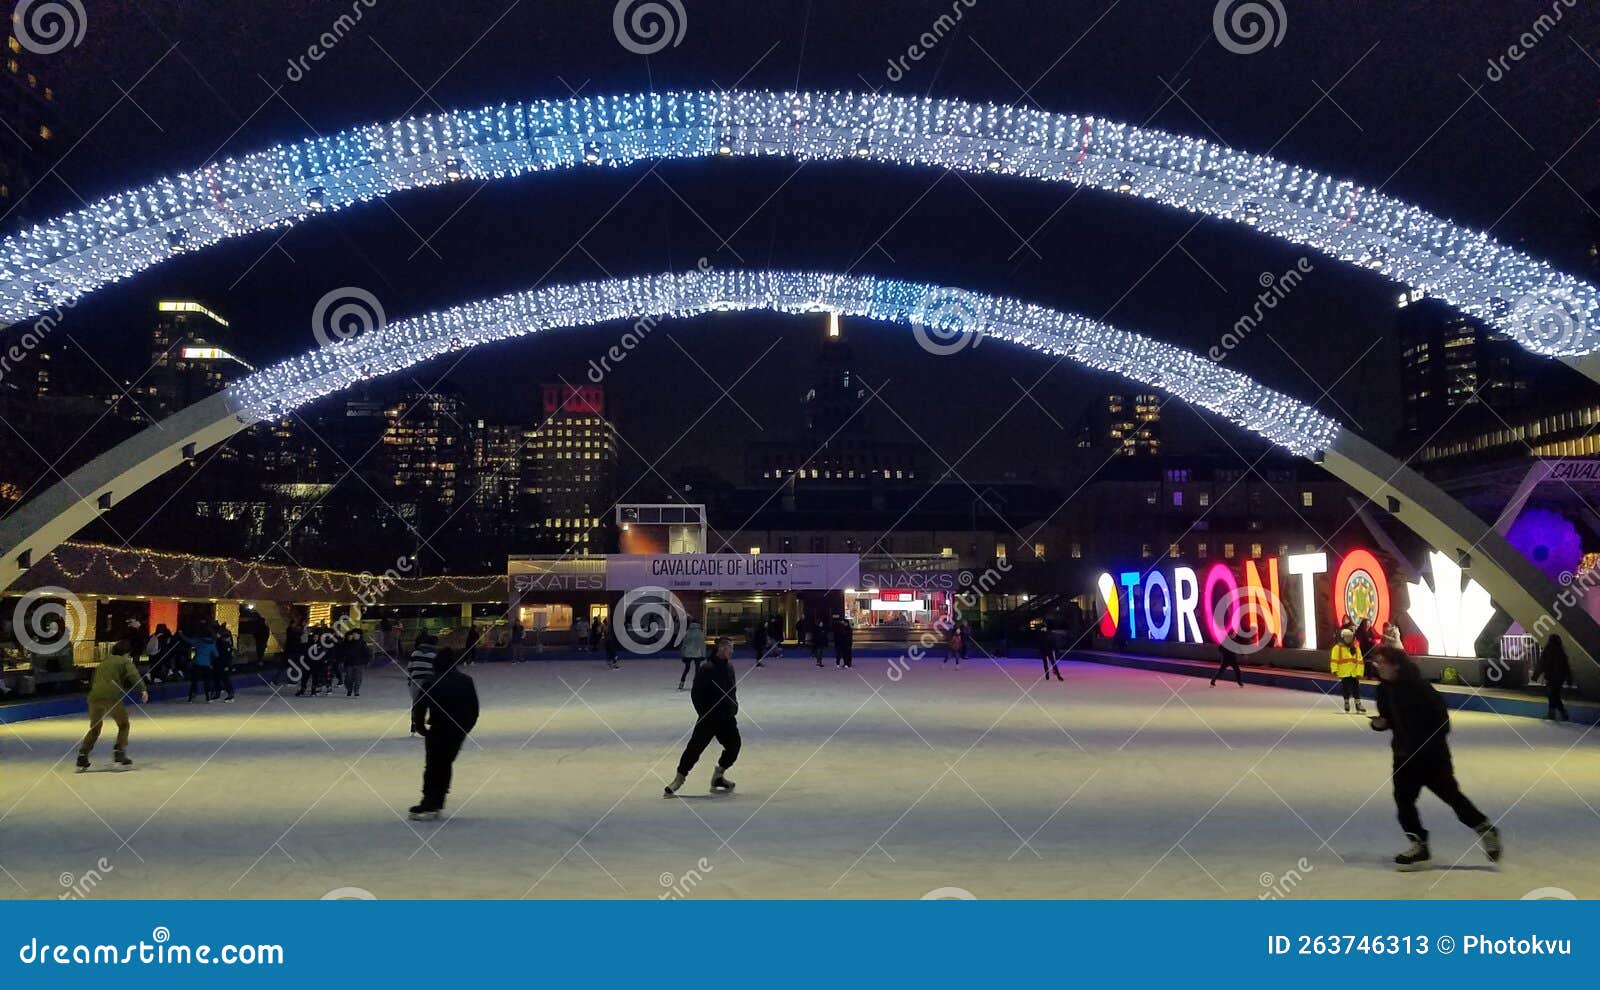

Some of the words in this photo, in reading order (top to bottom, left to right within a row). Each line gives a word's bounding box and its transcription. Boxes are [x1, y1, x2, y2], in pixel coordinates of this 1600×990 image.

[652, 559, 723, 576] CAVALCADE
[727, 559, 742, 576] OF
[746, 559, 788, 576] LIGHTS
[514, 574, 603, 590] SKATES
[862, 573, 953, 589] SNACKS
[1111, 549, 1390, 650] TORONTO
